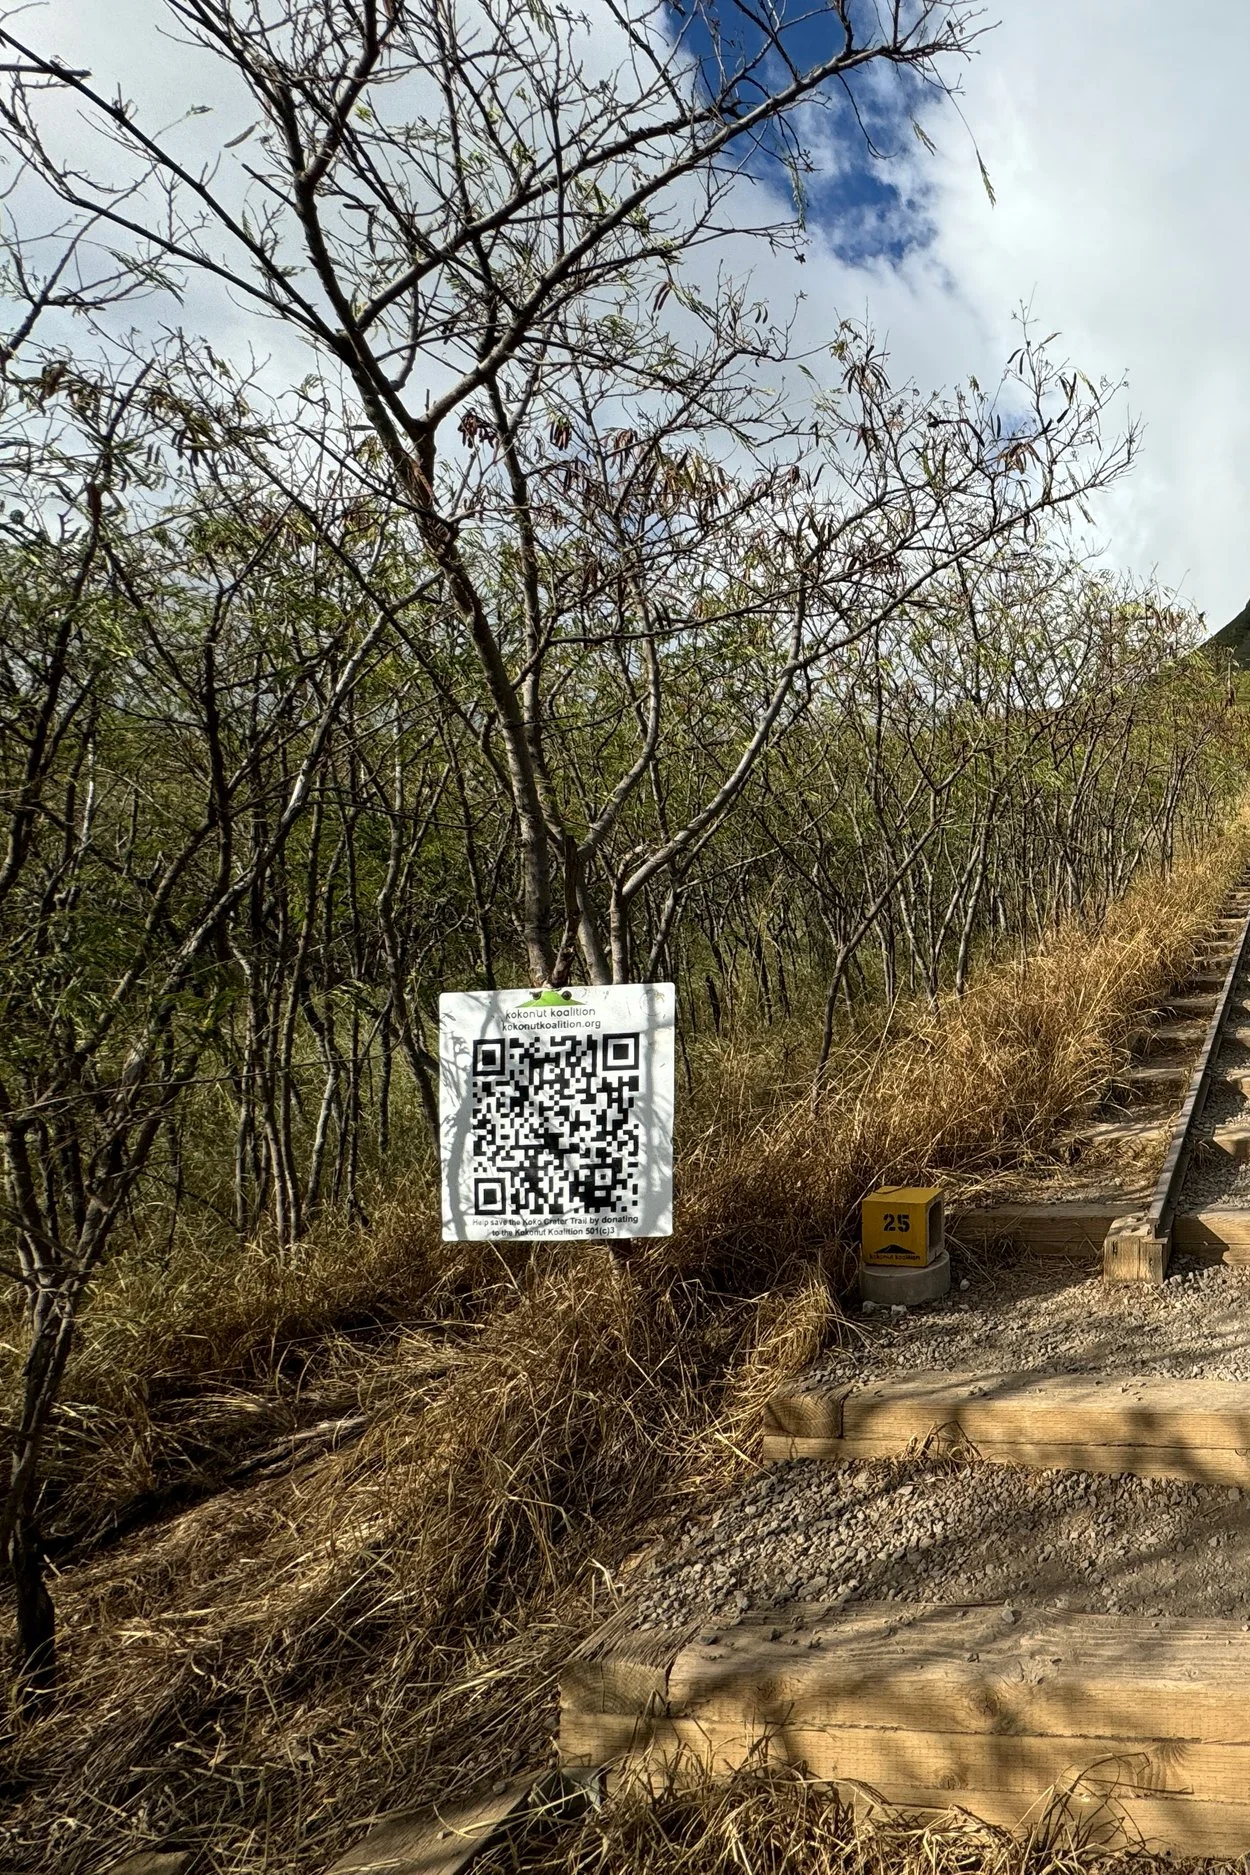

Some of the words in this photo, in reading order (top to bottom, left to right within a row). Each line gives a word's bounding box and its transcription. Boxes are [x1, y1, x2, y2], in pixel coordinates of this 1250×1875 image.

[505, 1008, 547, 1019] kokonut
[550, 1007, 596, 1017] koalition
[502, 1020, 601, 1031] kokonutkoalition.org
[523, 1218, 542, 1226] Koko
[589, 1217, 599, 1226] by
[601, 1215, 639, 1224] donating
[883, 1213, 910, 1232] 25
[515, 1228, 546, 1236] Kokonut
[548, 1227, 583, 1235] Koalition
[585, 1226, 615, 1236] 501(c)3
